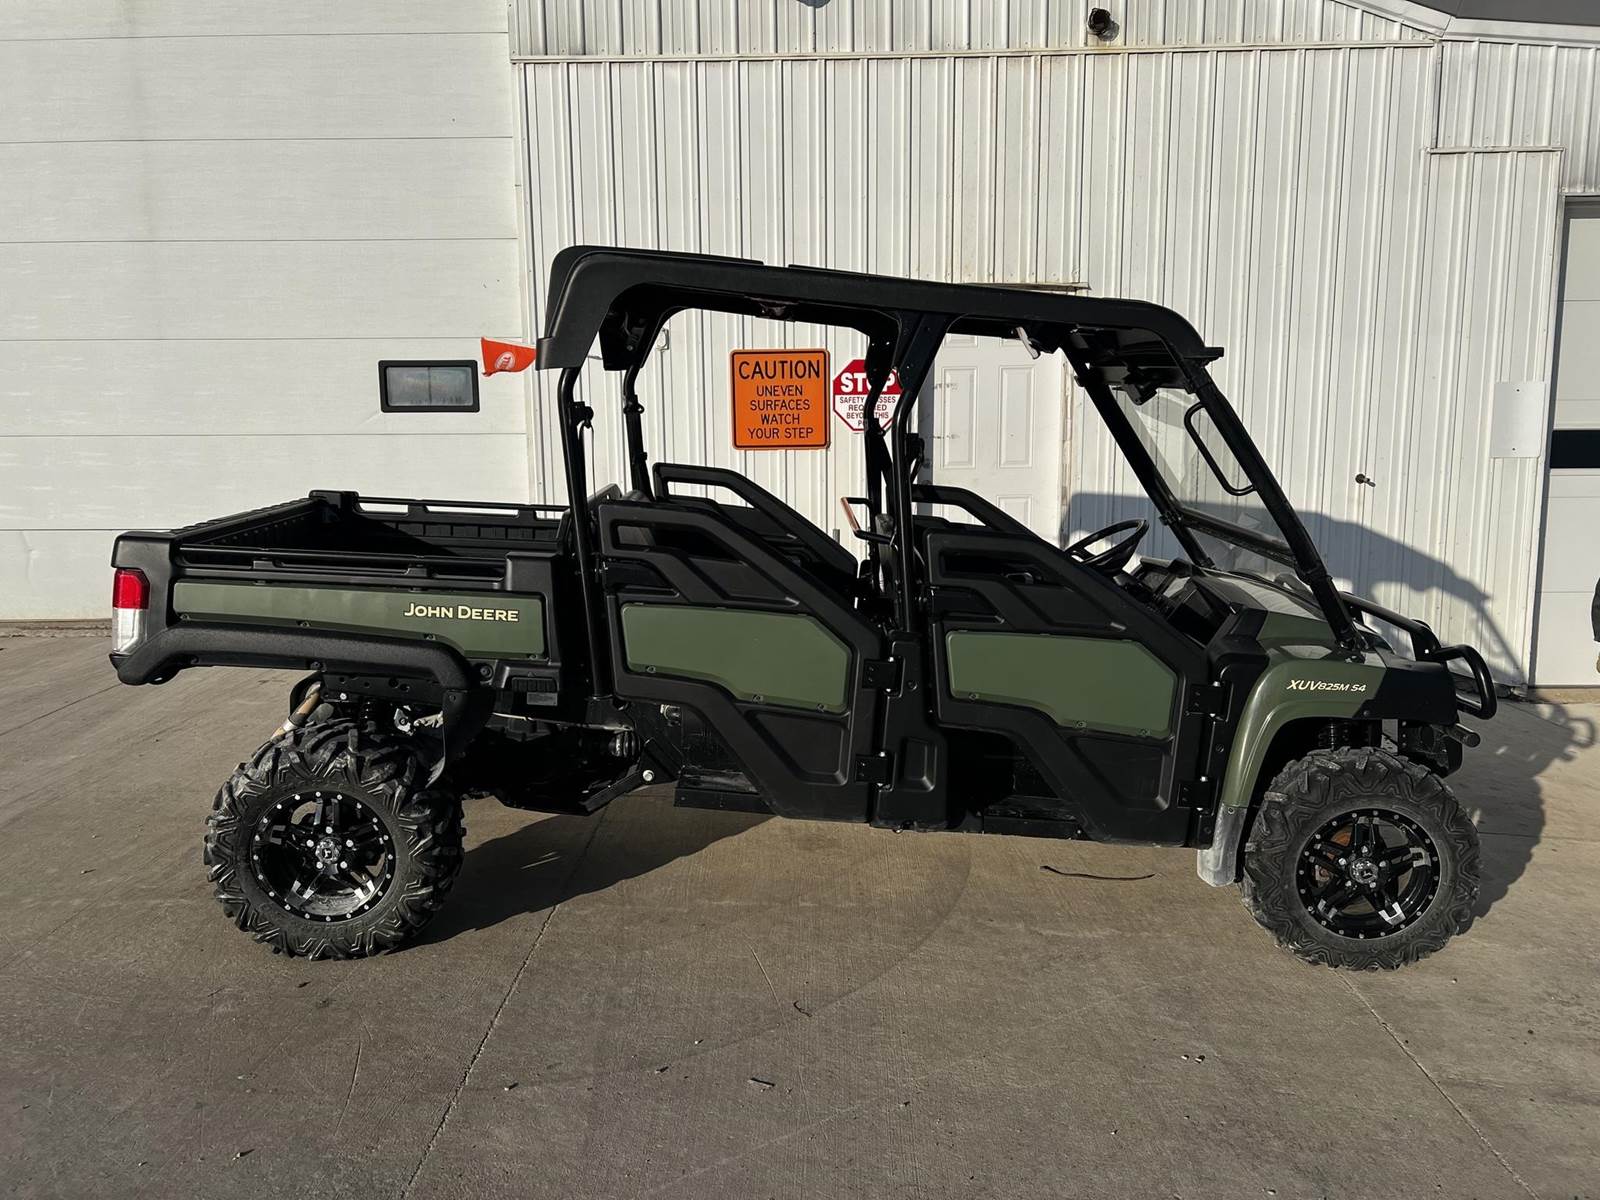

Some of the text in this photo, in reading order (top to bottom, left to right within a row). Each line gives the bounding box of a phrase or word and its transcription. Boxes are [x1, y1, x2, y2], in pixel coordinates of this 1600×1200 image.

[738, 360, 820, 380] CAUTION
[840, 372, 896, 393] STP
[756, 385, 803, 397] UNEVEN
[750, 399, 811, 411] SURFACES
[839, 396, 865, 404] SAFETY
[760, 413, 800, 425] WATCH
[874, 411, 889, 419] THIS
[748, 427, 814, 439] YOUR STEP
[404, 602, 519, 622] JOHN DEERE
[1286, 679, 1367, 692] XUV825M S4
